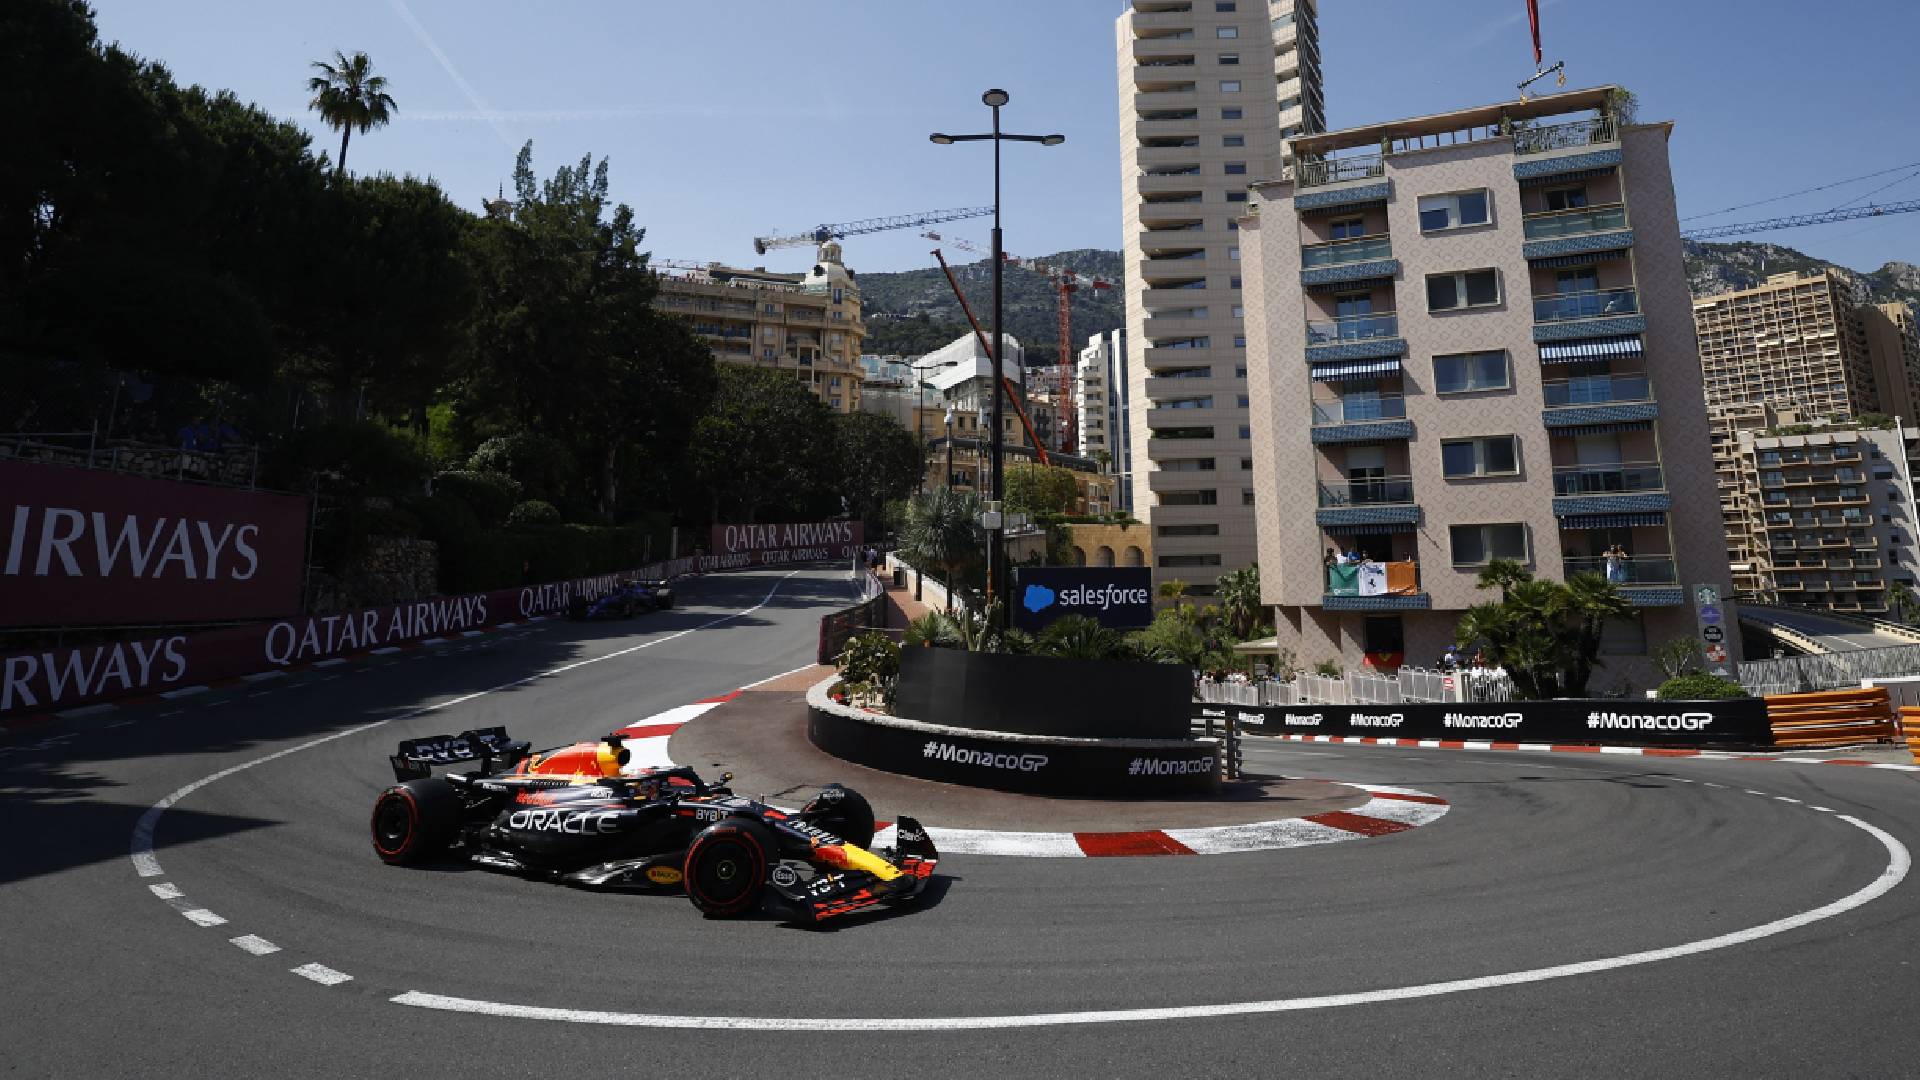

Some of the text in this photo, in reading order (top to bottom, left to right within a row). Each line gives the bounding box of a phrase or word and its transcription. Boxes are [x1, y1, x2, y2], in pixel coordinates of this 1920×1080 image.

[4, 505, 259, 580] IRWAYS
[725, 521, 853, 551] QATAR AIRWAYS
[519, 580, 570, 616] QATAR
[1059, 583, 1148, 610] salesforce
[265, 593, 488, 665] QATAR AIRWAYS
[1350, 713, 1404, 727] #MonacoGP
[1443, 712, 1523, 729] #MonacoGP
[1587, 711, 1713, 731] #MonacoGP
[923, 741, 1049, 772] #MonacoGP
[1128, 756, 1214, 775] #MonacoGP
[509, 810, 620, 835] ORACLE
